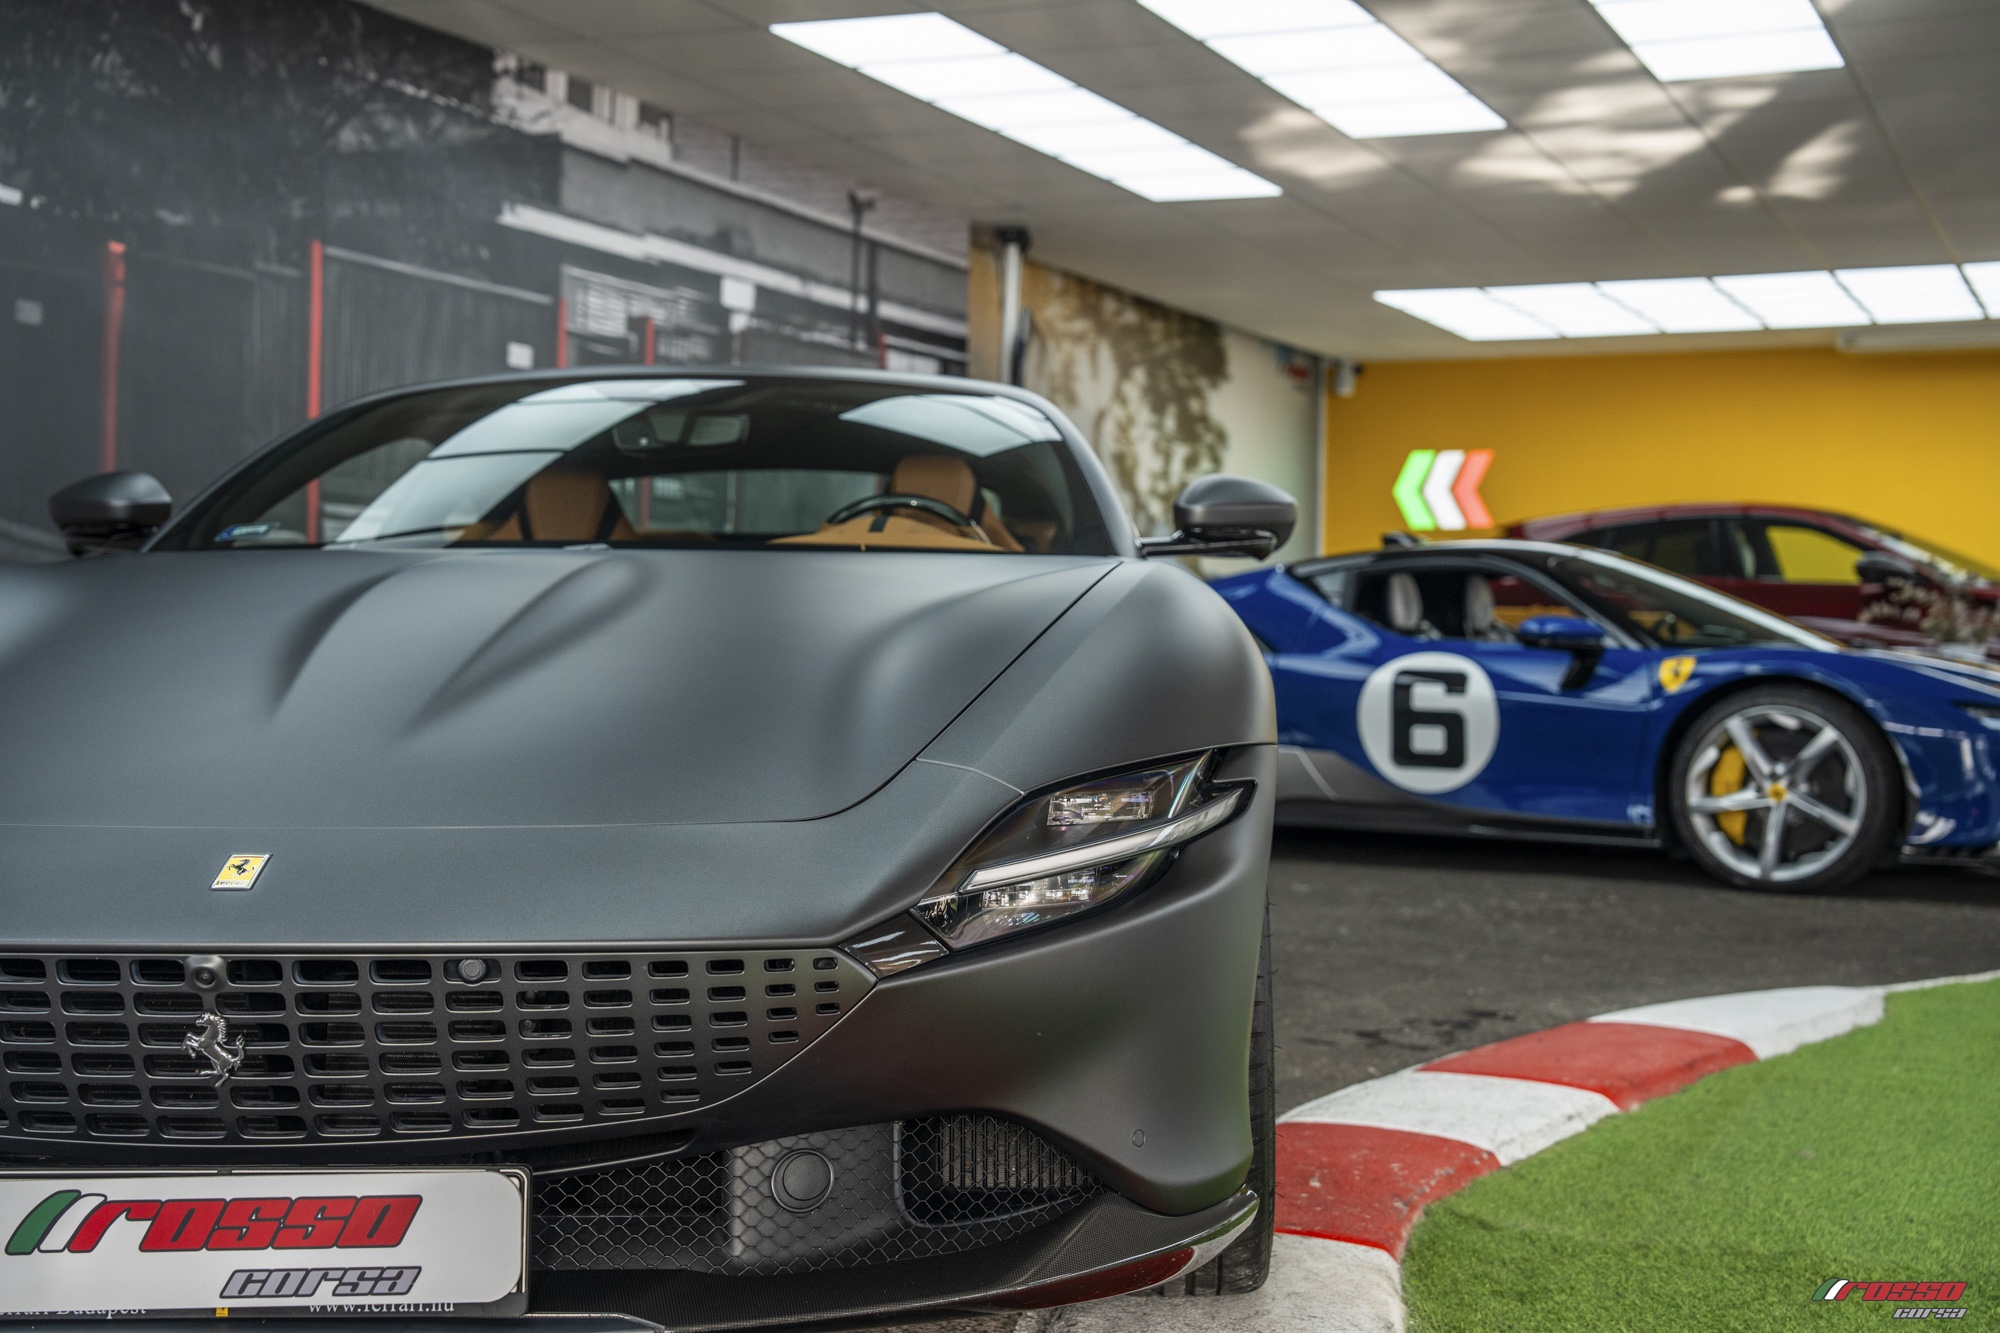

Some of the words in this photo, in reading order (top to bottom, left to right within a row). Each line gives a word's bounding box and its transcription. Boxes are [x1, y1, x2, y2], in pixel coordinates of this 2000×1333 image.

[1392, 670, 1468, 768] 6
[67, 1194, 423, 1254] rosso
[218, 1265, 422, 1299] corsa
